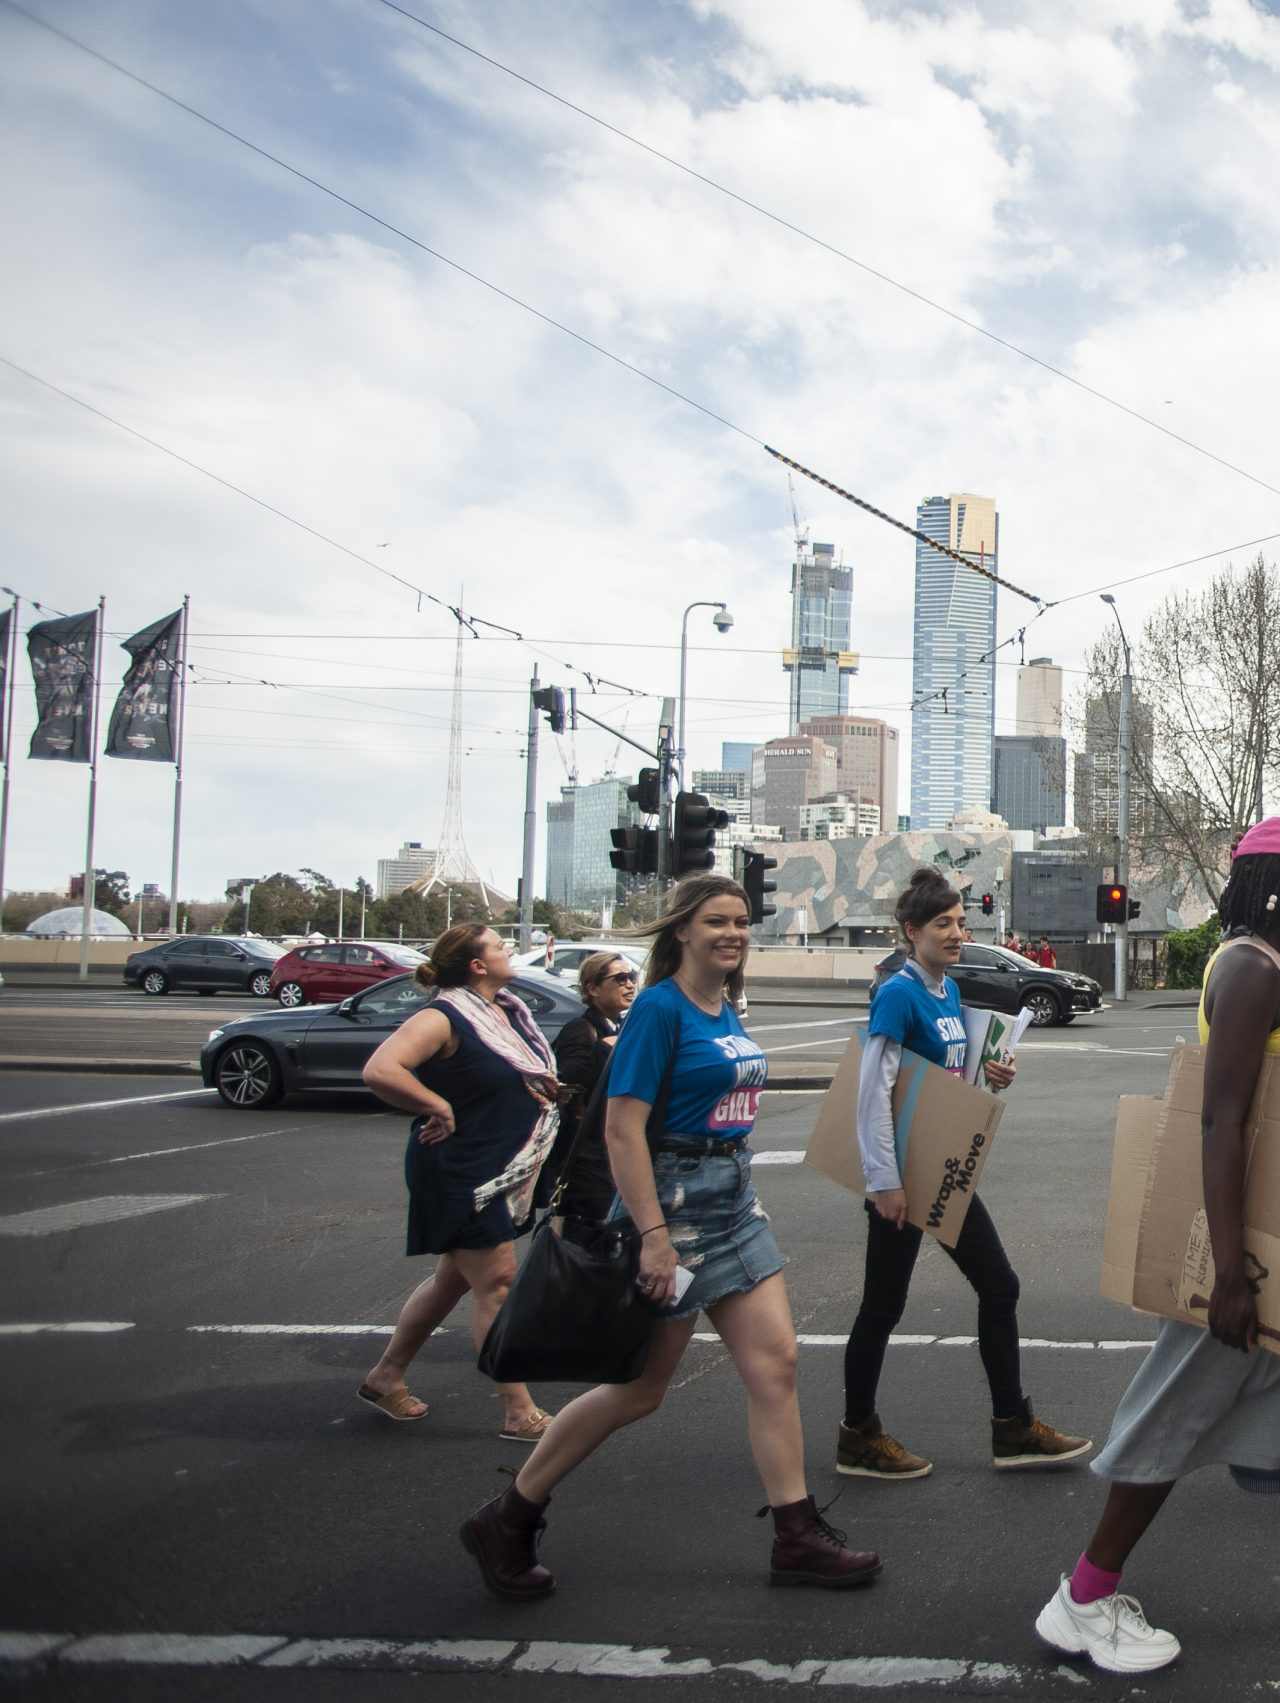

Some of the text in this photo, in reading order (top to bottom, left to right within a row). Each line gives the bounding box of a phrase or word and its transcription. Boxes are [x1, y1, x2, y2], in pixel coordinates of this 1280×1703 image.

[764, 747, 812, 756] HERALD SUN
[955, 1132, 986, 1193] Move
[1182, 1214, 1206, 1285] TIME IS
